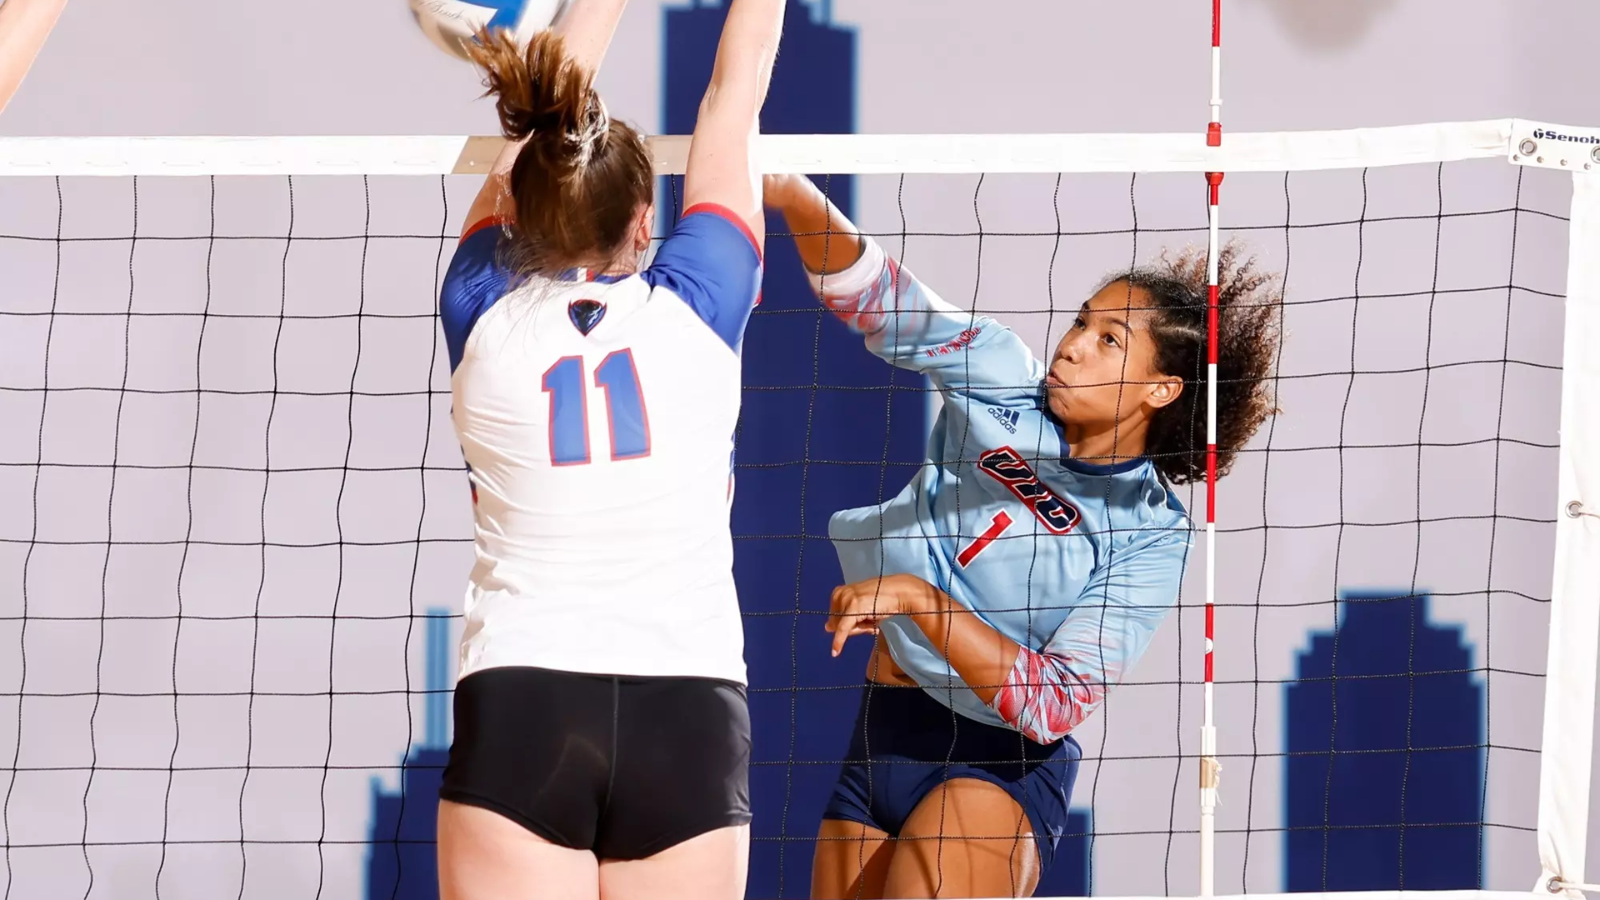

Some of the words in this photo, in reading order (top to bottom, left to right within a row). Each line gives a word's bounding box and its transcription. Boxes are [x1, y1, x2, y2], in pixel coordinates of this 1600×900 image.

[541, 347, 652, 467] 11
[987, 406, 1017, 435] adidas
[977, 445, 1082, 535] UIC
[955, 508, 1015, 570] 1
